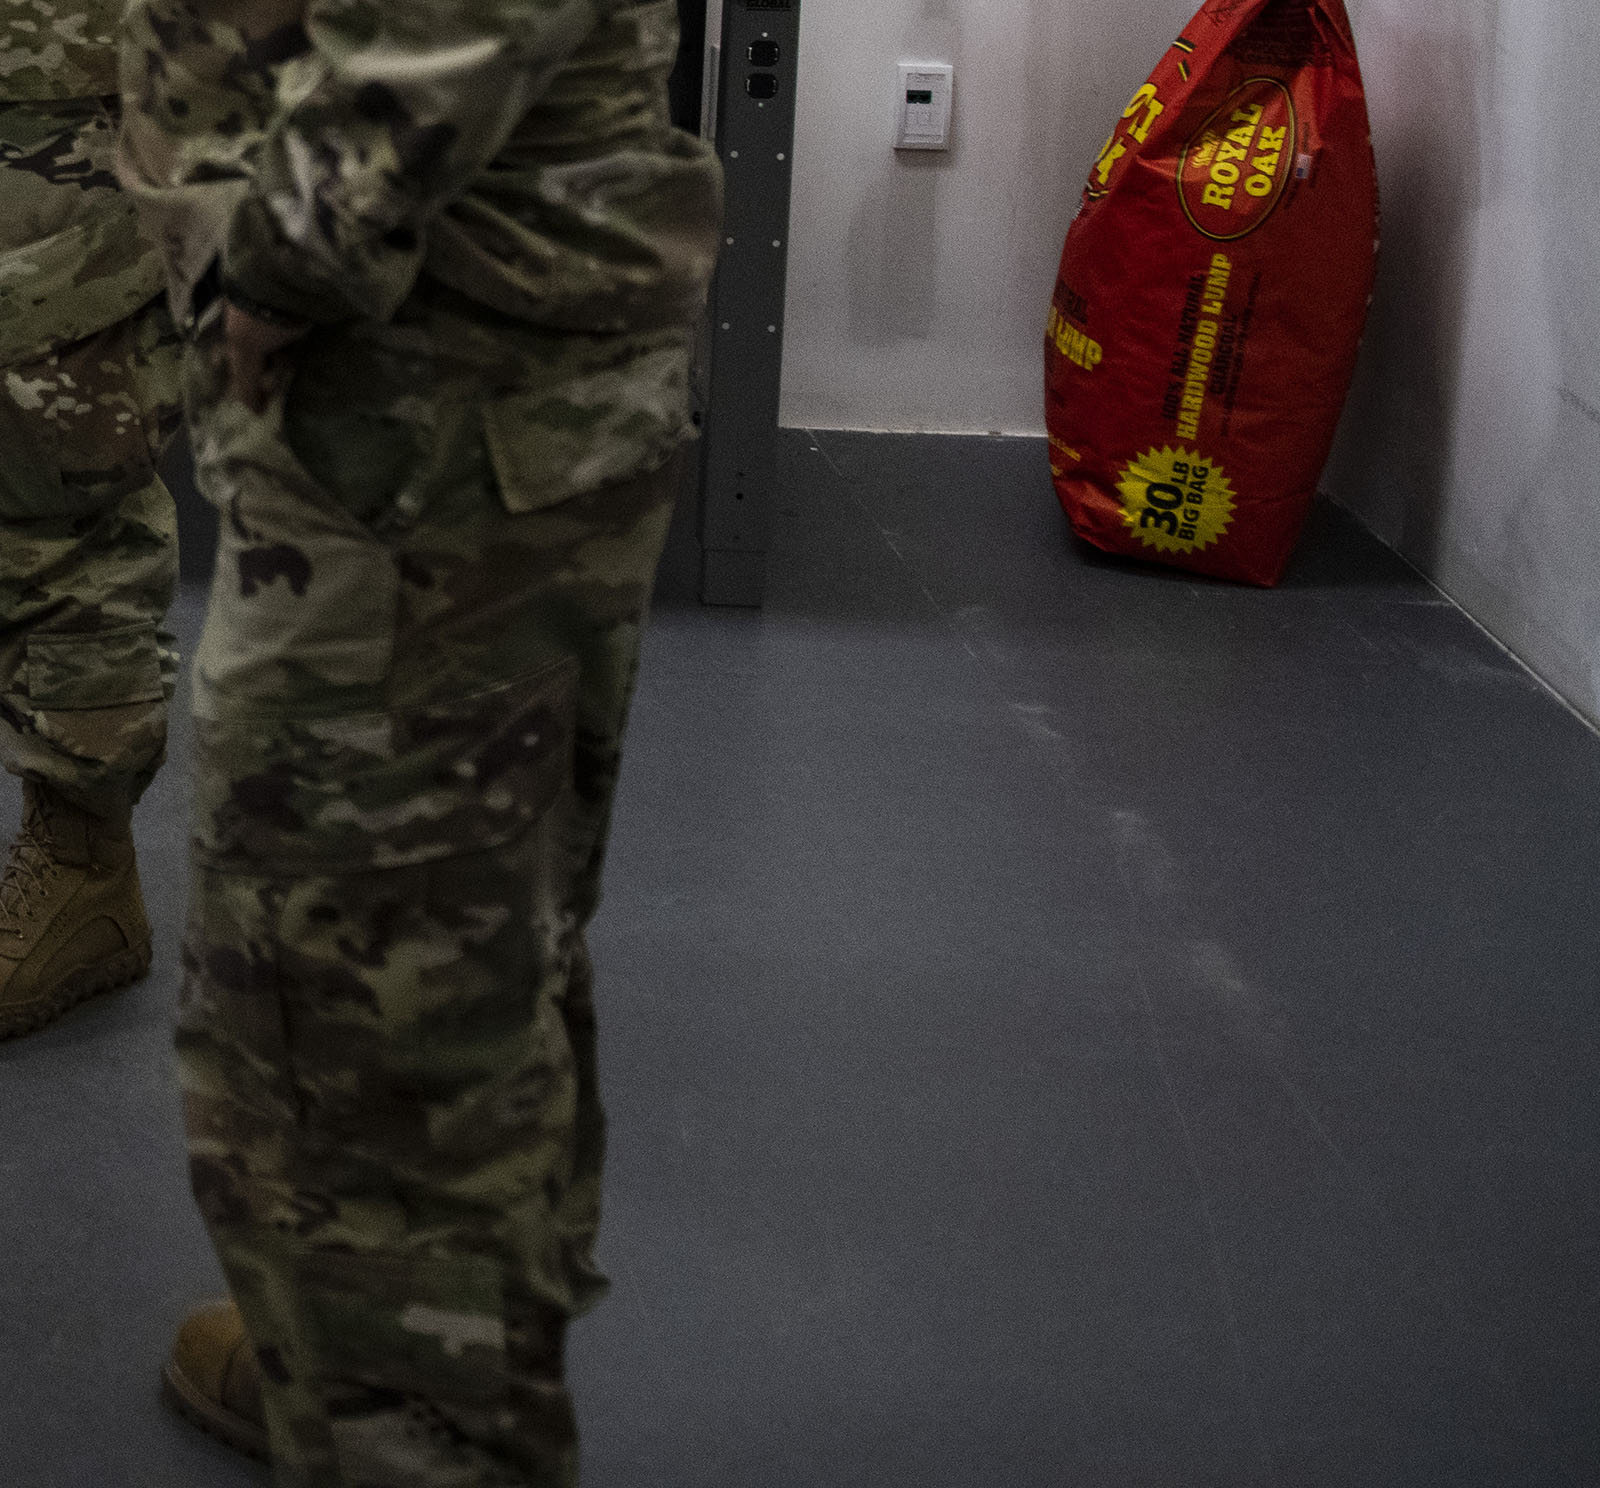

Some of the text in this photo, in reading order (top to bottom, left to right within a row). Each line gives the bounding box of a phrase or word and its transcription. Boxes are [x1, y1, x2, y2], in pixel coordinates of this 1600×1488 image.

[746, 0, 792, 9] GLOBAL
[1202, 103, 1265, 211] ROYAL
[1244, 126, 1288, 197] OAK
[1175, 252, 1233, 441] HARDWOOD LUMP
[1178, 274, 1204, 344] NATURAL
[1209, 313, 1238, 395] CHARCOAL
[1140, 461, 1190, 537] 30 LB
[1178, 465, 1210, 541] BIG BAG
